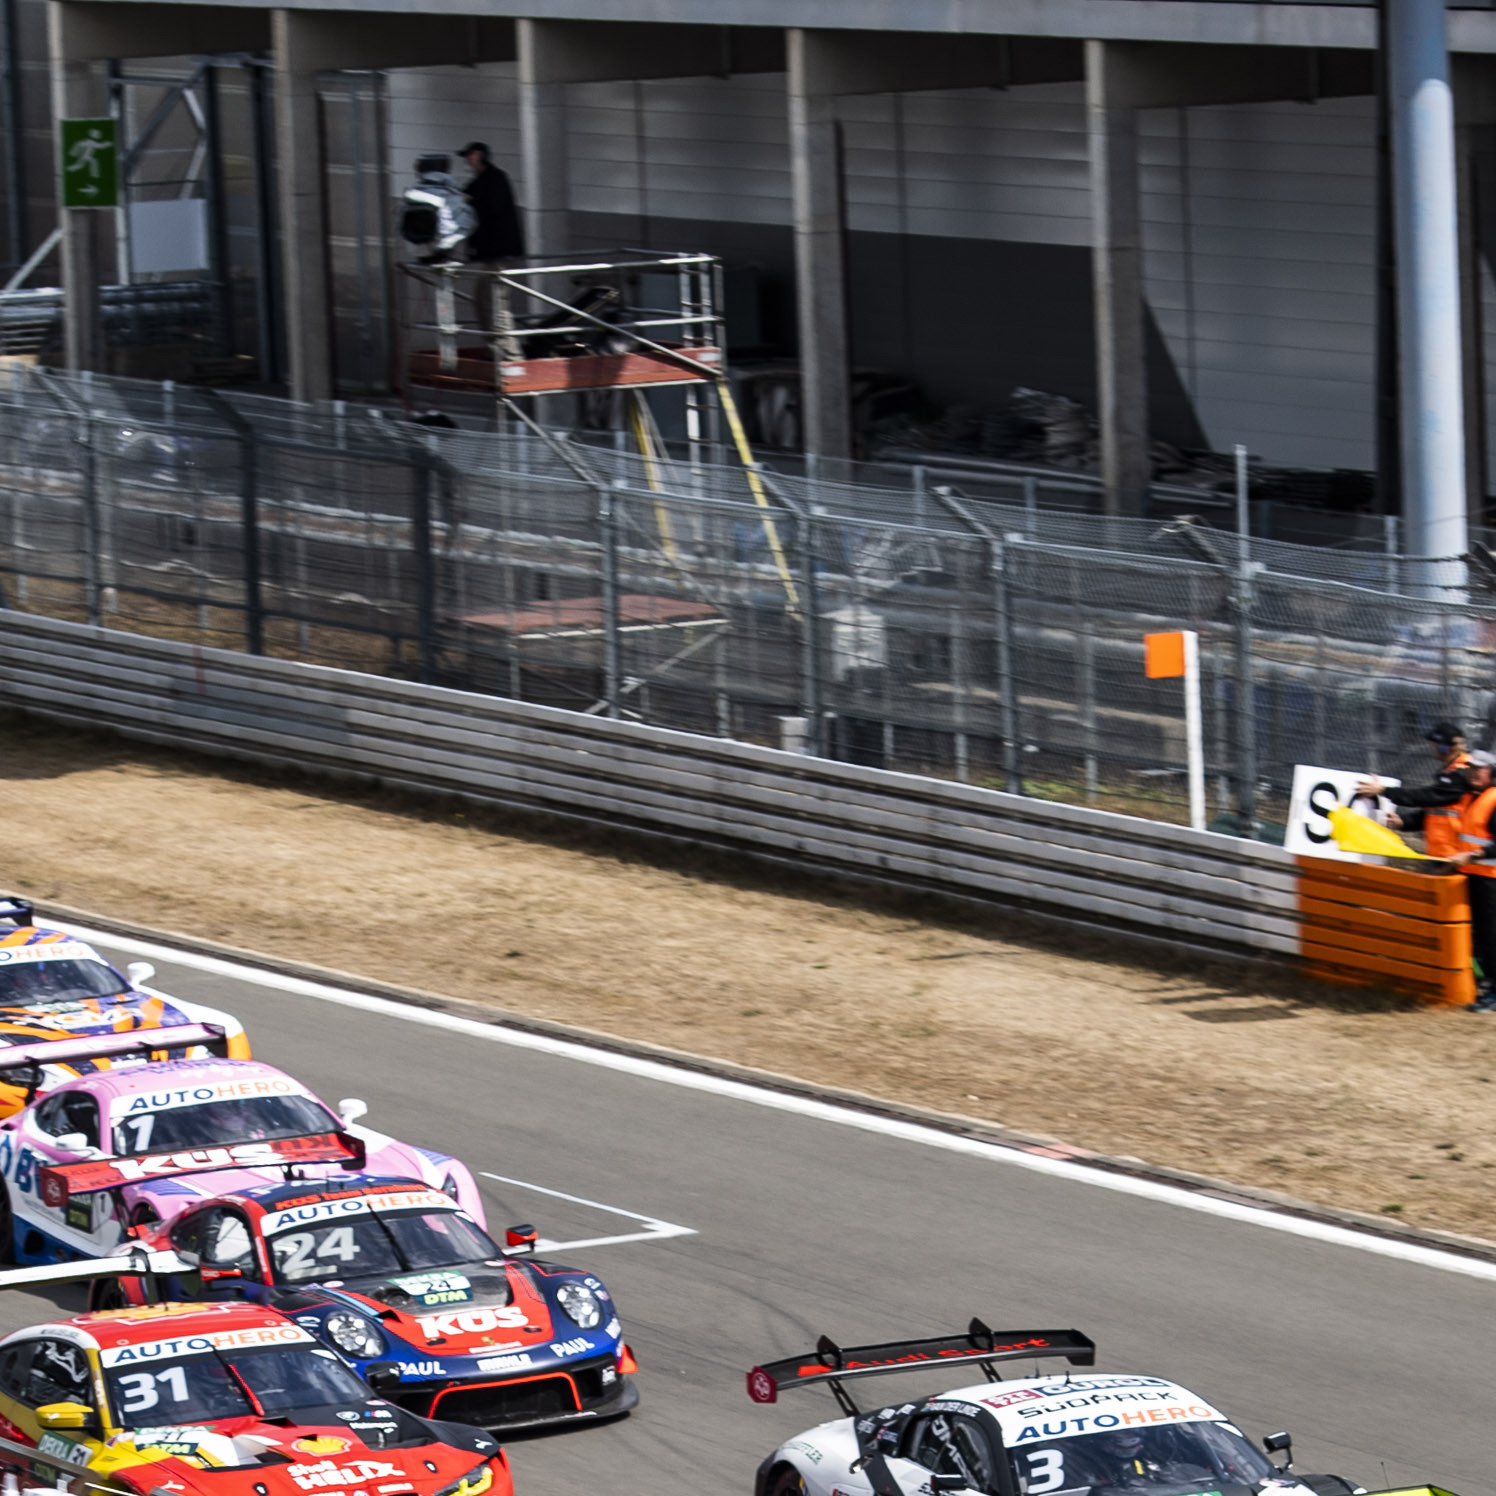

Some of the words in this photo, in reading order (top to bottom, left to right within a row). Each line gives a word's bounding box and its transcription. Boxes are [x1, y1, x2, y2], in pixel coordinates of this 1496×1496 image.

[129, 1080, 291, 1112] AUTOHERO
[126, 1114, 156, 1152] 1
[276, 1193, 446, 1228] AUTOHERO
[279, 1226, 361, 1276] 24
[423, 1290, 468, 1306] DTM
[113, 1326, 303, 1364] AUTOHERO
[550, 1337, 596, 1358] PAUL
[117, 1365, 191, 1413] 31
[1016, 1390, 1175, 1419] SÜDPACK
[1015, 1404, 1213, 1443] AUTOHERO
[286, 1459, 339, 1478] Shell
[291, 1460, 407, 1491] HELIX
[1025, 1448, 1065, 1496] 3
